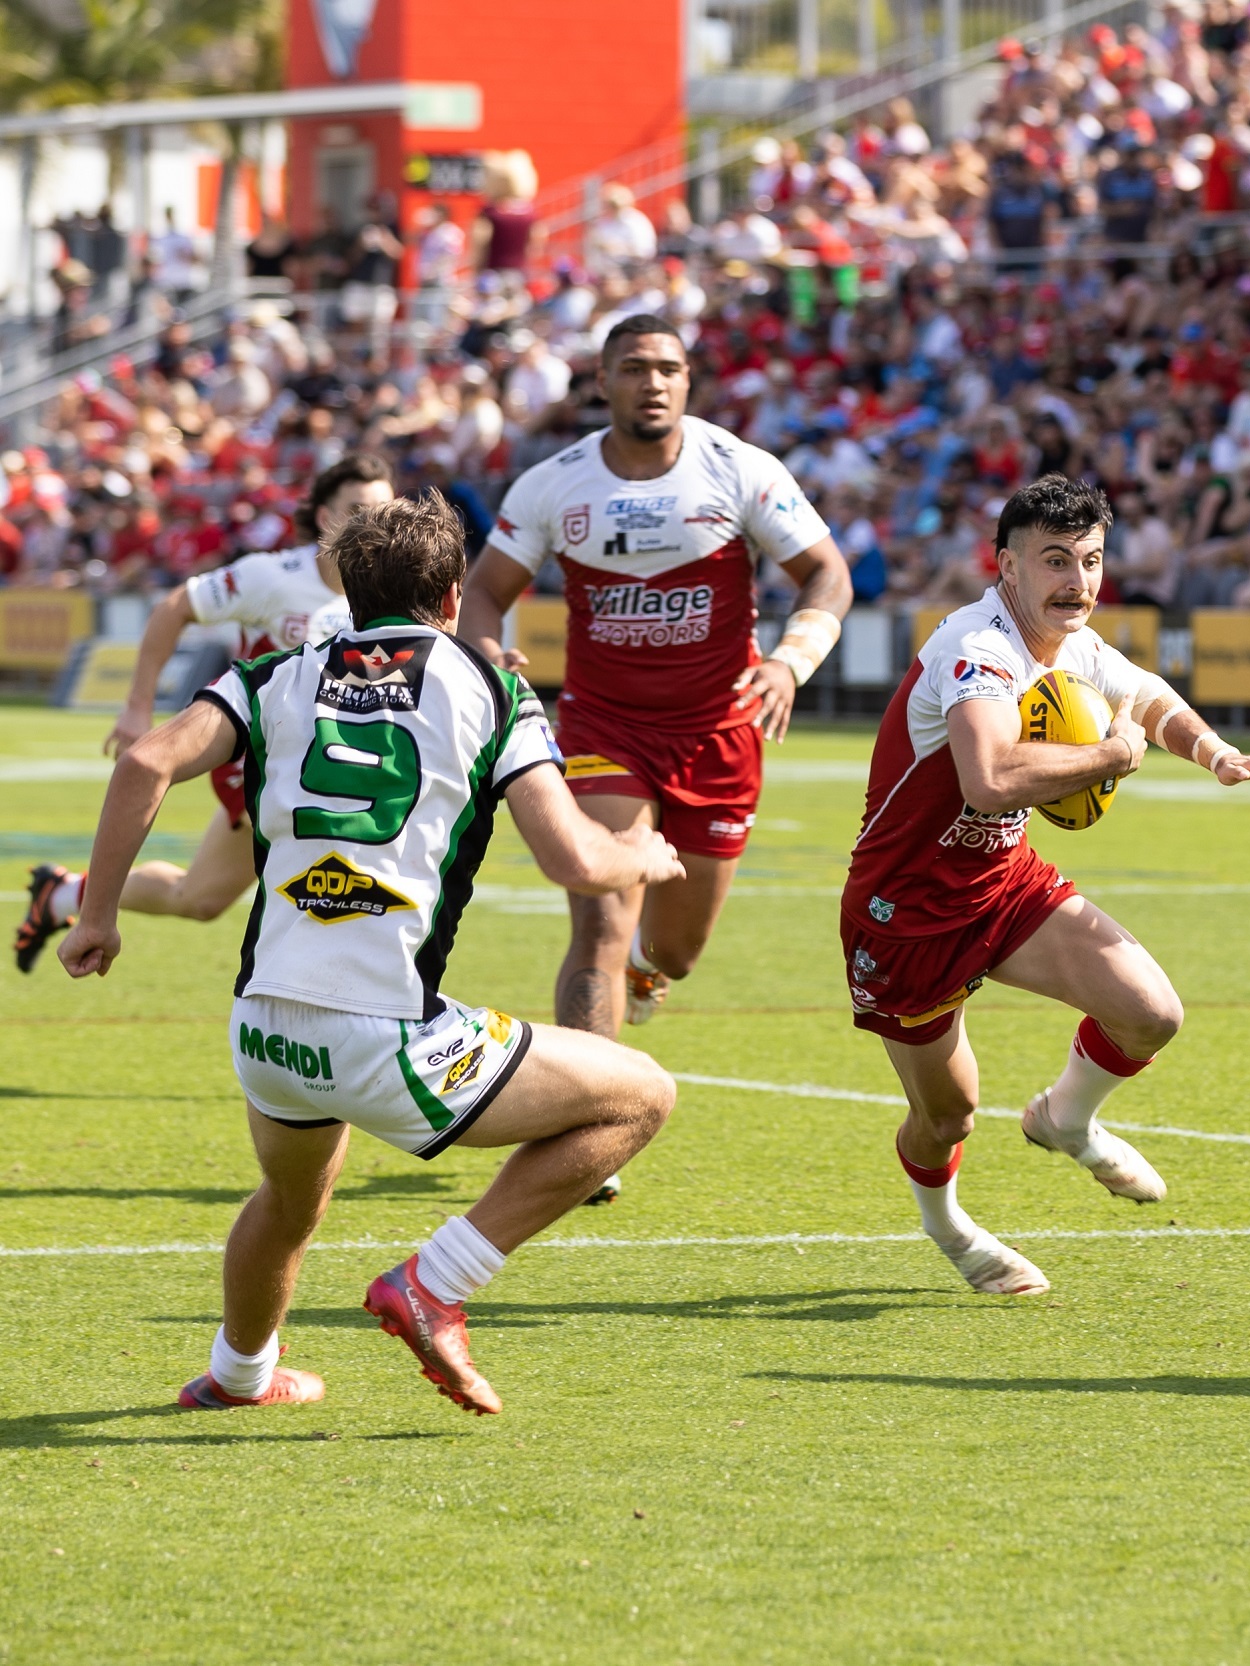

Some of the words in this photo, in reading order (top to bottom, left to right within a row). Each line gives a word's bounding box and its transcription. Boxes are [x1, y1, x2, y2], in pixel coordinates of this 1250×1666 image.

[585, 583, 714, 624] Village
[588, 620, 710, 647] MOTORS
[1030, 703, 1047, 741] STE
[293, 717, 422, 846] 9
[306, 870, 374, 897] QDP
[240, 1022, 333, 1080] MENDI
[304, 1082, 336, 1092] GROUP
[405, 1287, 433, 1351] ULTRA
